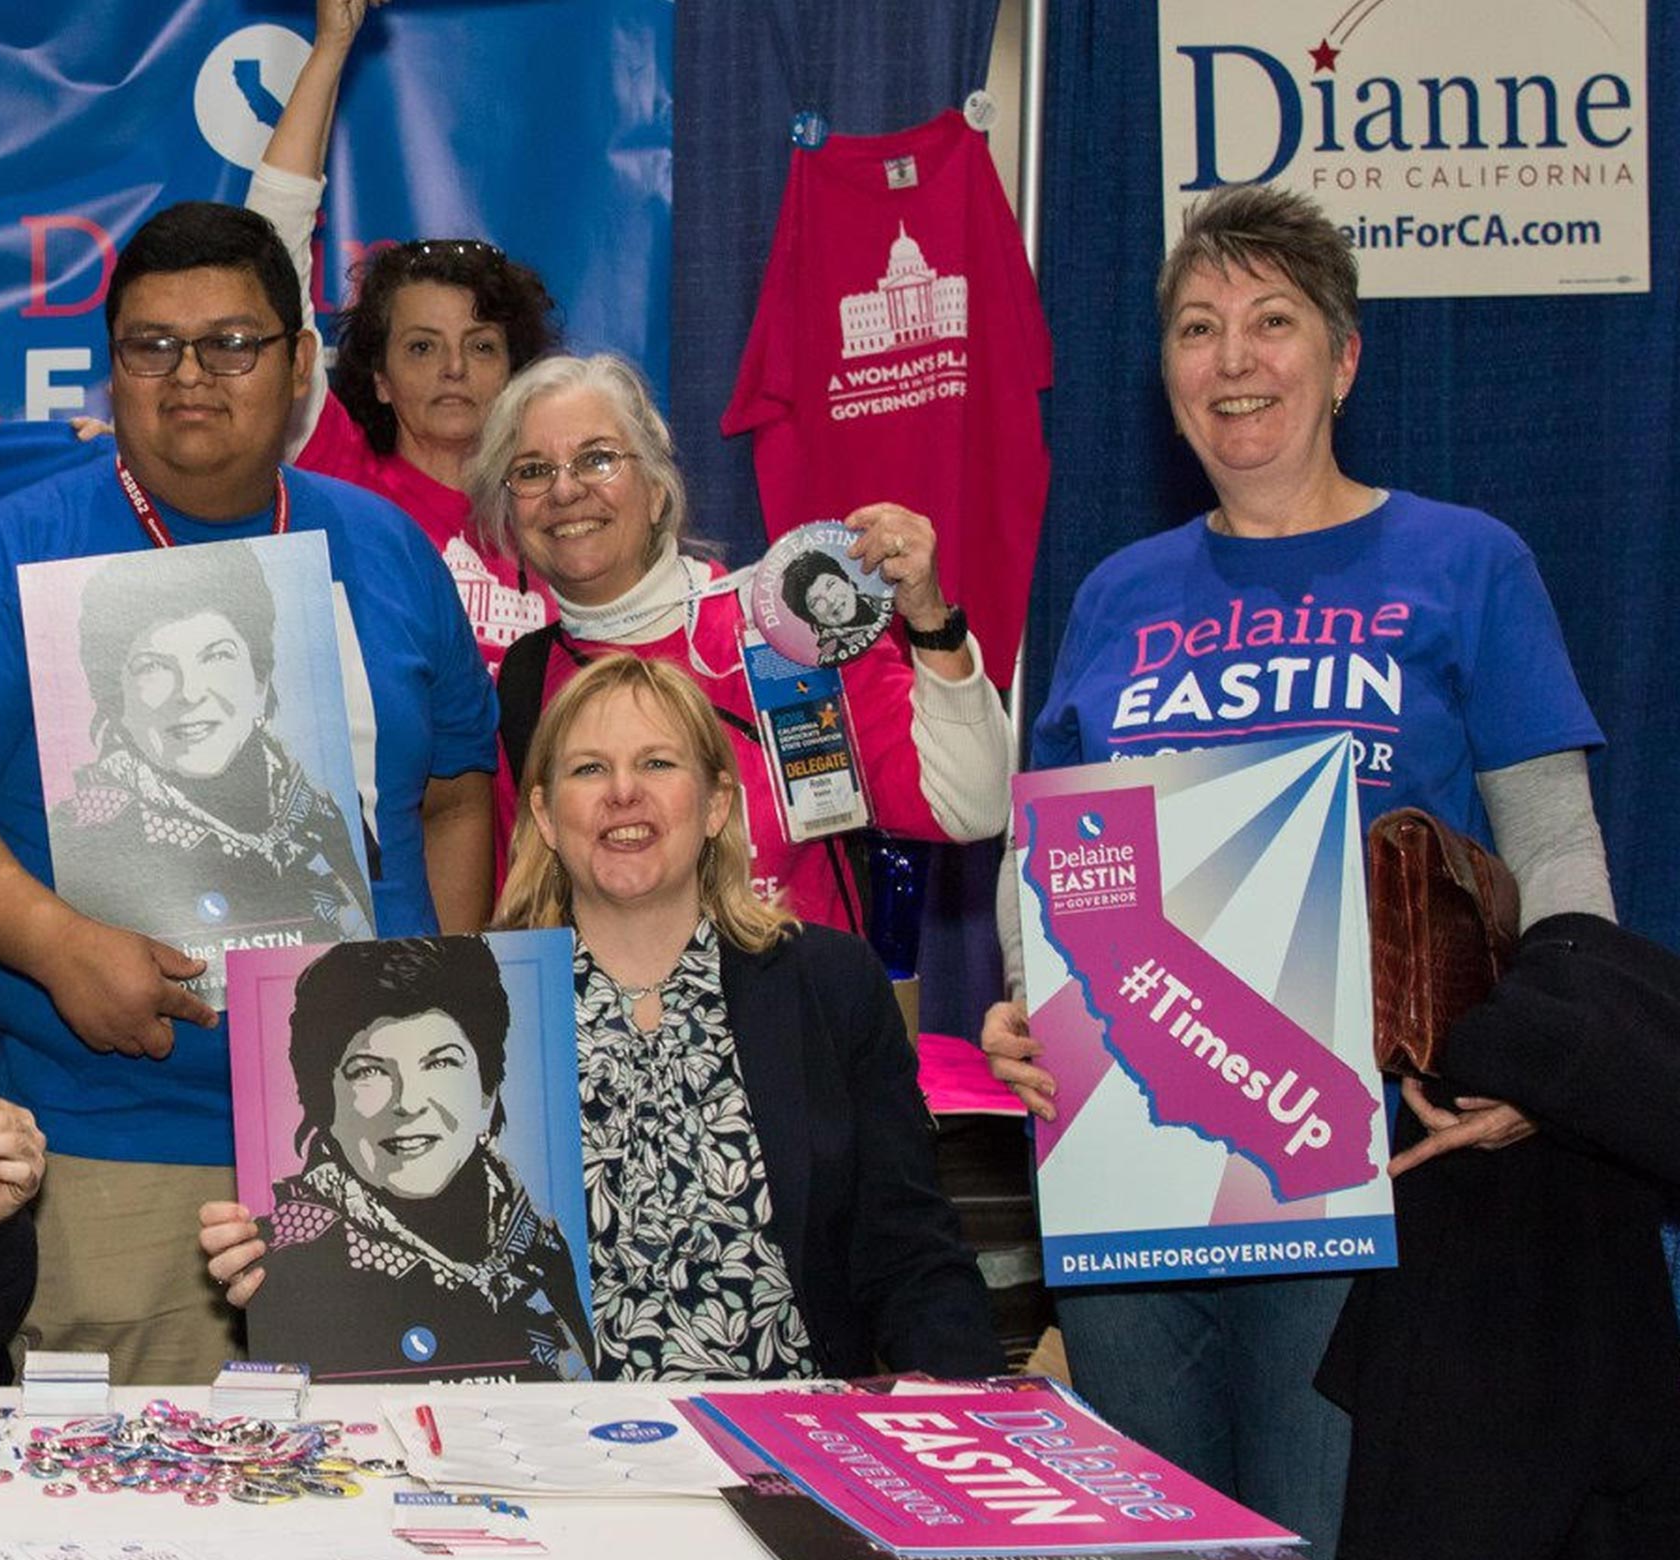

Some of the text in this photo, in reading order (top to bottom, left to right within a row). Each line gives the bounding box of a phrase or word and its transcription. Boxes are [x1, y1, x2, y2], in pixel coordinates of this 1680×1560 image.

[1176, 38, 1633, 192] Dianne
[1312, 163, 1634, 190] FOR CALIFORNIA
[828, 374, 844, 392] A
[845, 355, 936, 388] WOMAN'S
[1129, 593, 1411, 678] Delaine
[1111, 652, 1403, 729] EASTIN
[784, 751, 849, 779] DELEGATE
[1047, 843, 1135, 870] Delaine
[1050, 864, 1137, 894] EASTIN
[1066, 891, 1137, 909] GOVERNOR
[1117, 957, 1333, 1157] #TimesUp
[1062, 1237, 1376, 1273] DELAINEFORGOVERNOR.COM
[856, 1411, 1106, 1526] EASTIN
[963, 1408, 1196, 1522] Delaine
